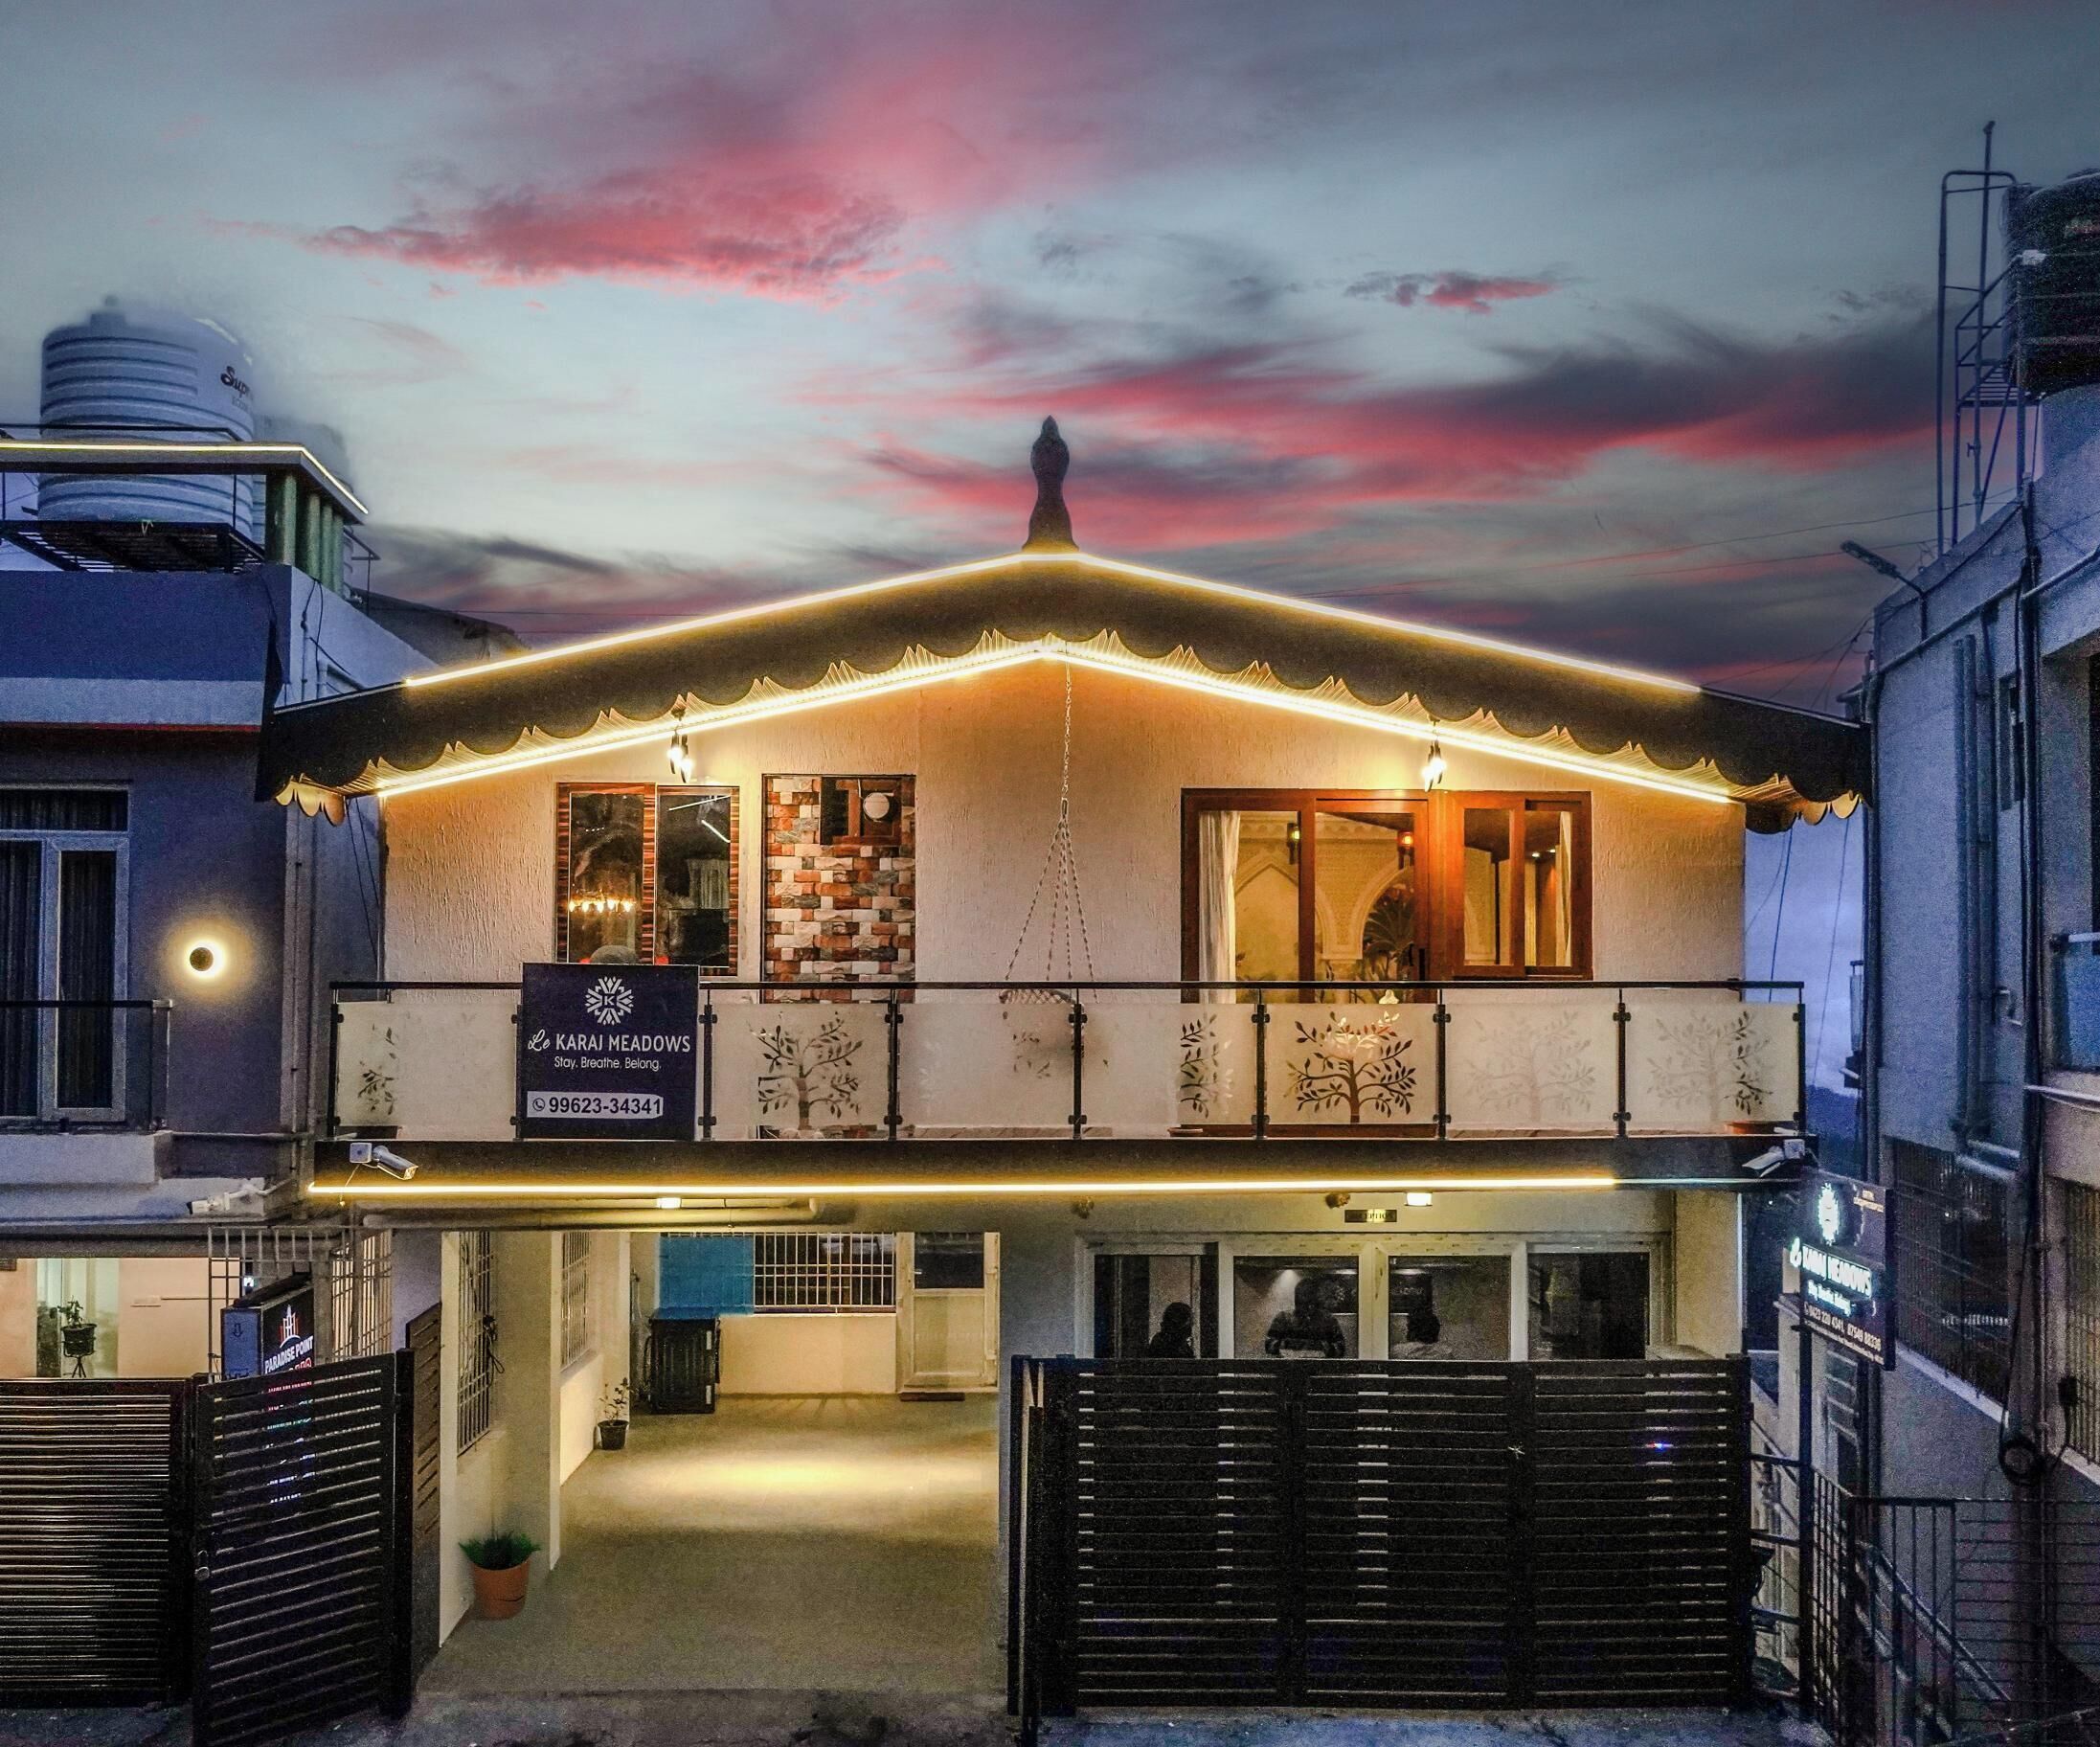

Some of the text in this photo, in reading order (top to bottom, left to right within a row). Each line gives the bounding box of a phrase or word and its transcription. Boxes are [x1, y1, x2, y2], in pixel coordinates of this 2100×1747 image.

[220, 366, 253, 399] Sup
[528, 1029, 690, 1053] Le KARAJ MEADOWS
[554, 1056, 578, 1069] Stay.
[624, 1057, 662, 1072] Belong.
[549, 1097, 661, 1115] 99623-34341
[264, 1346, 296, 1374] PARADISE
[296, 1335, 314, 1358] POINT
